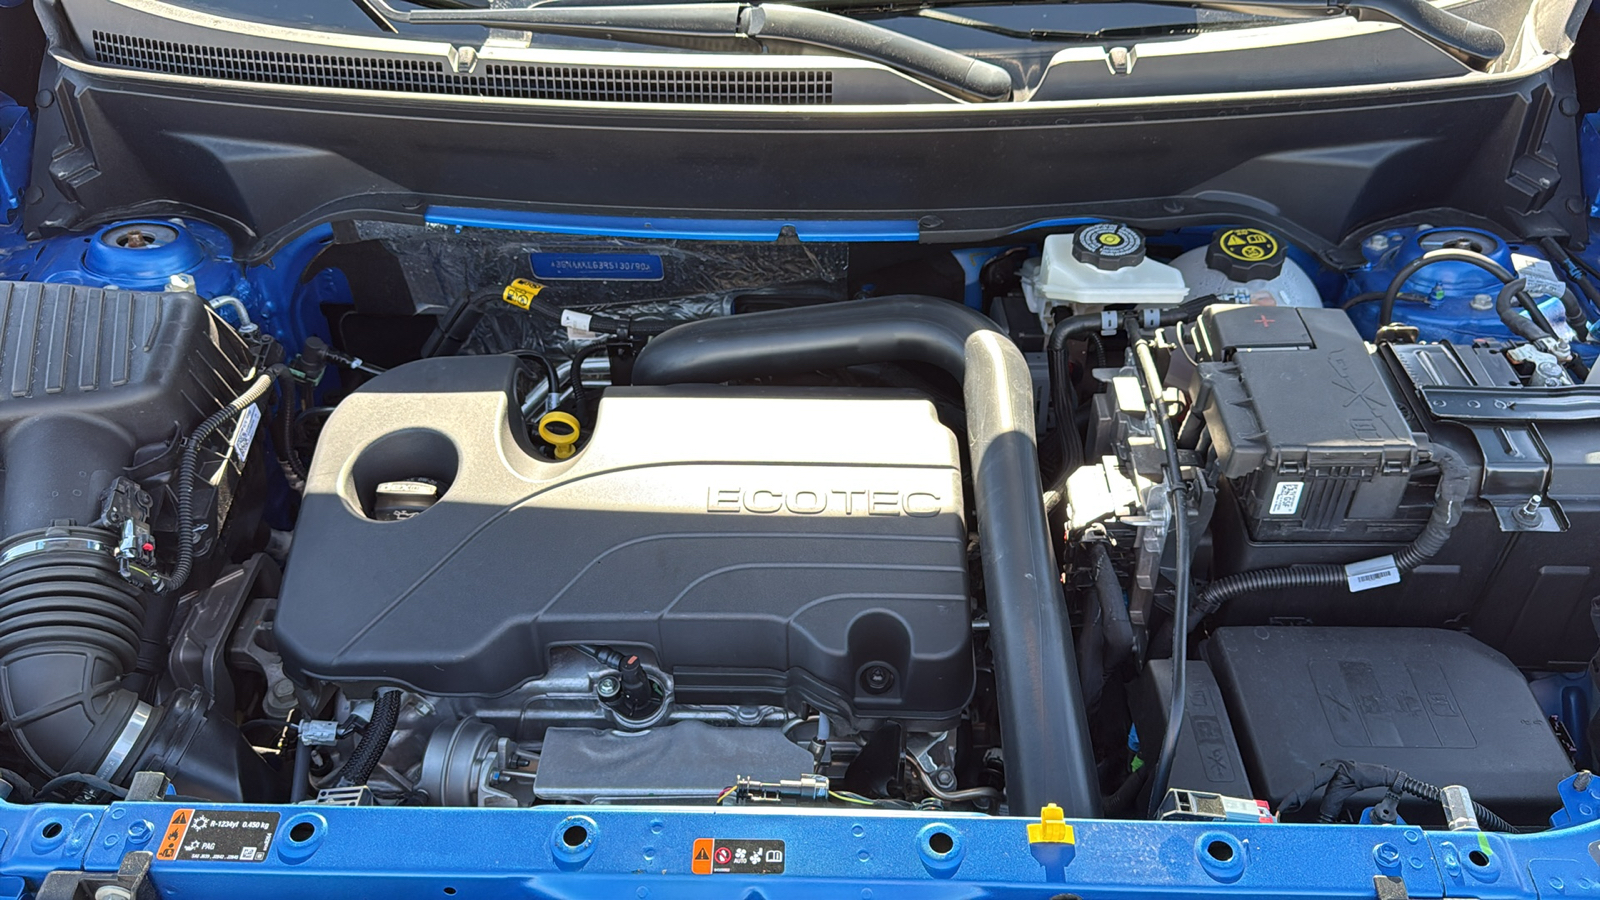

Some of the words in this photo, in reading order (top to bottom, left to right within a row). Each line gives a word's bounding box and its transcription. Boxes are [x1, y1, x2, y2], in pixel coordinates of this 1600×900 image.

[707, 486, 942, 518] ECOTEC
[210, 820, 239, 829] R-1234yf
[242, 821, 260, 829] 0.450
[260, 822, 270, 830] kg
[201, 842, 216, 850] PAG
